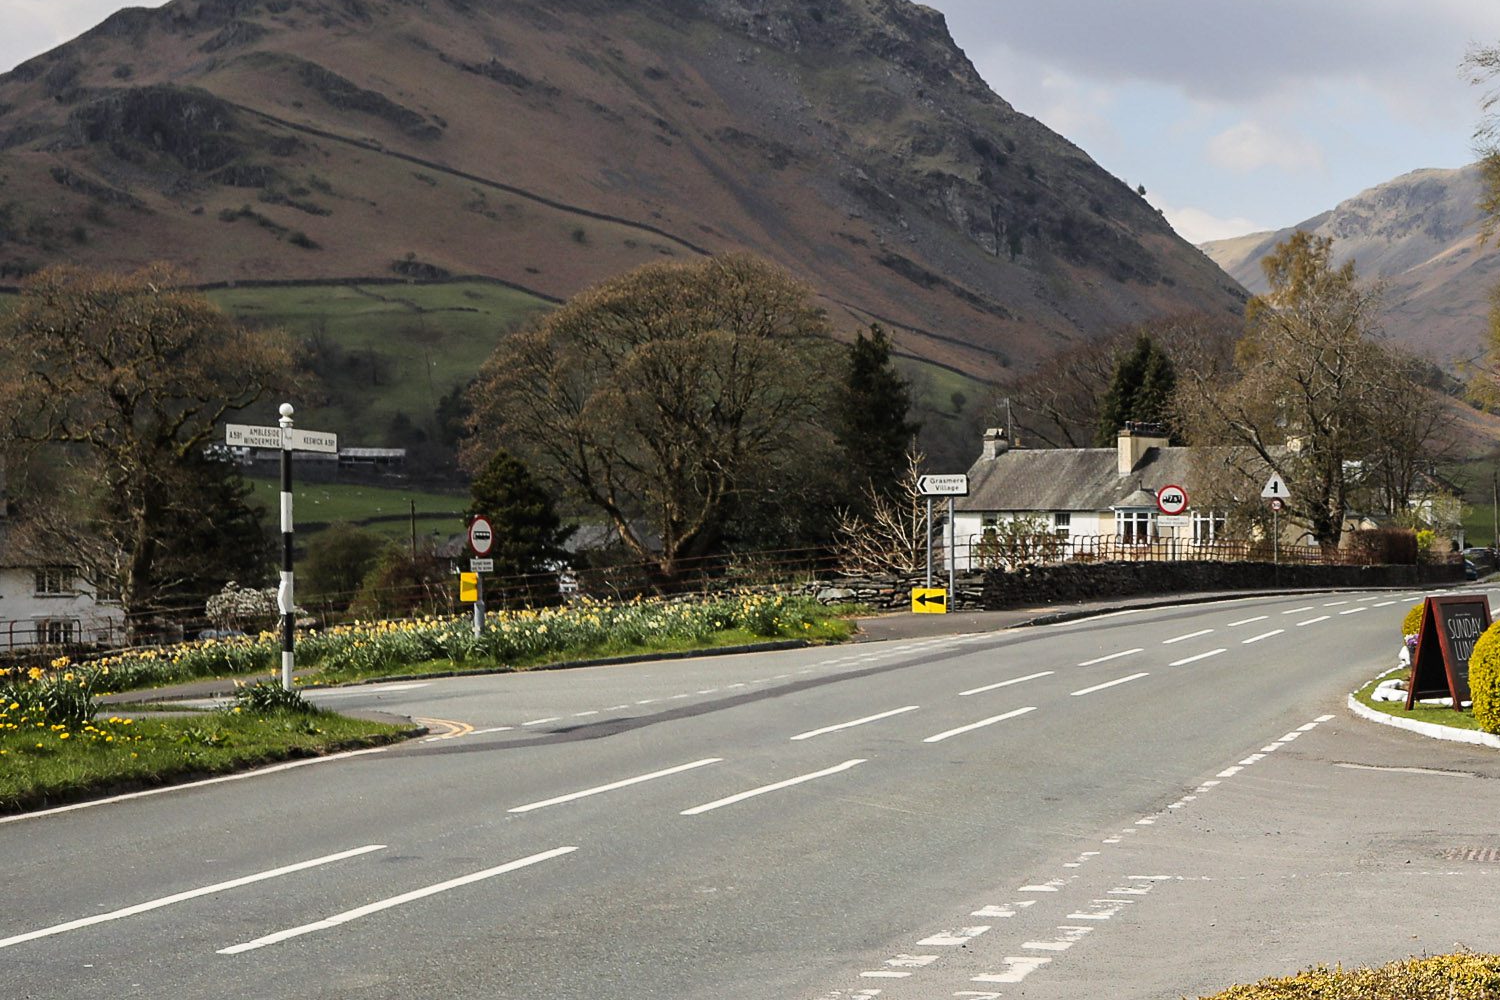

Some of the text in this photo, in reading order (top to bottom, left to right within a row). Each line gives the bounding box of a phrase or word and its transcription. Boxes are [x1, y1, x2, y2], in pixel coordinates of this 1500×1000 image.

[250, 428, 280, 438] AMBLESIDE
[244, 437, 280, 447] WINDERMERE
[303, 437, 323, 446] KESWICK
[1448, 617, 1481, 639] SUNDAY
[1455, 640, 1476, 661] LUN
